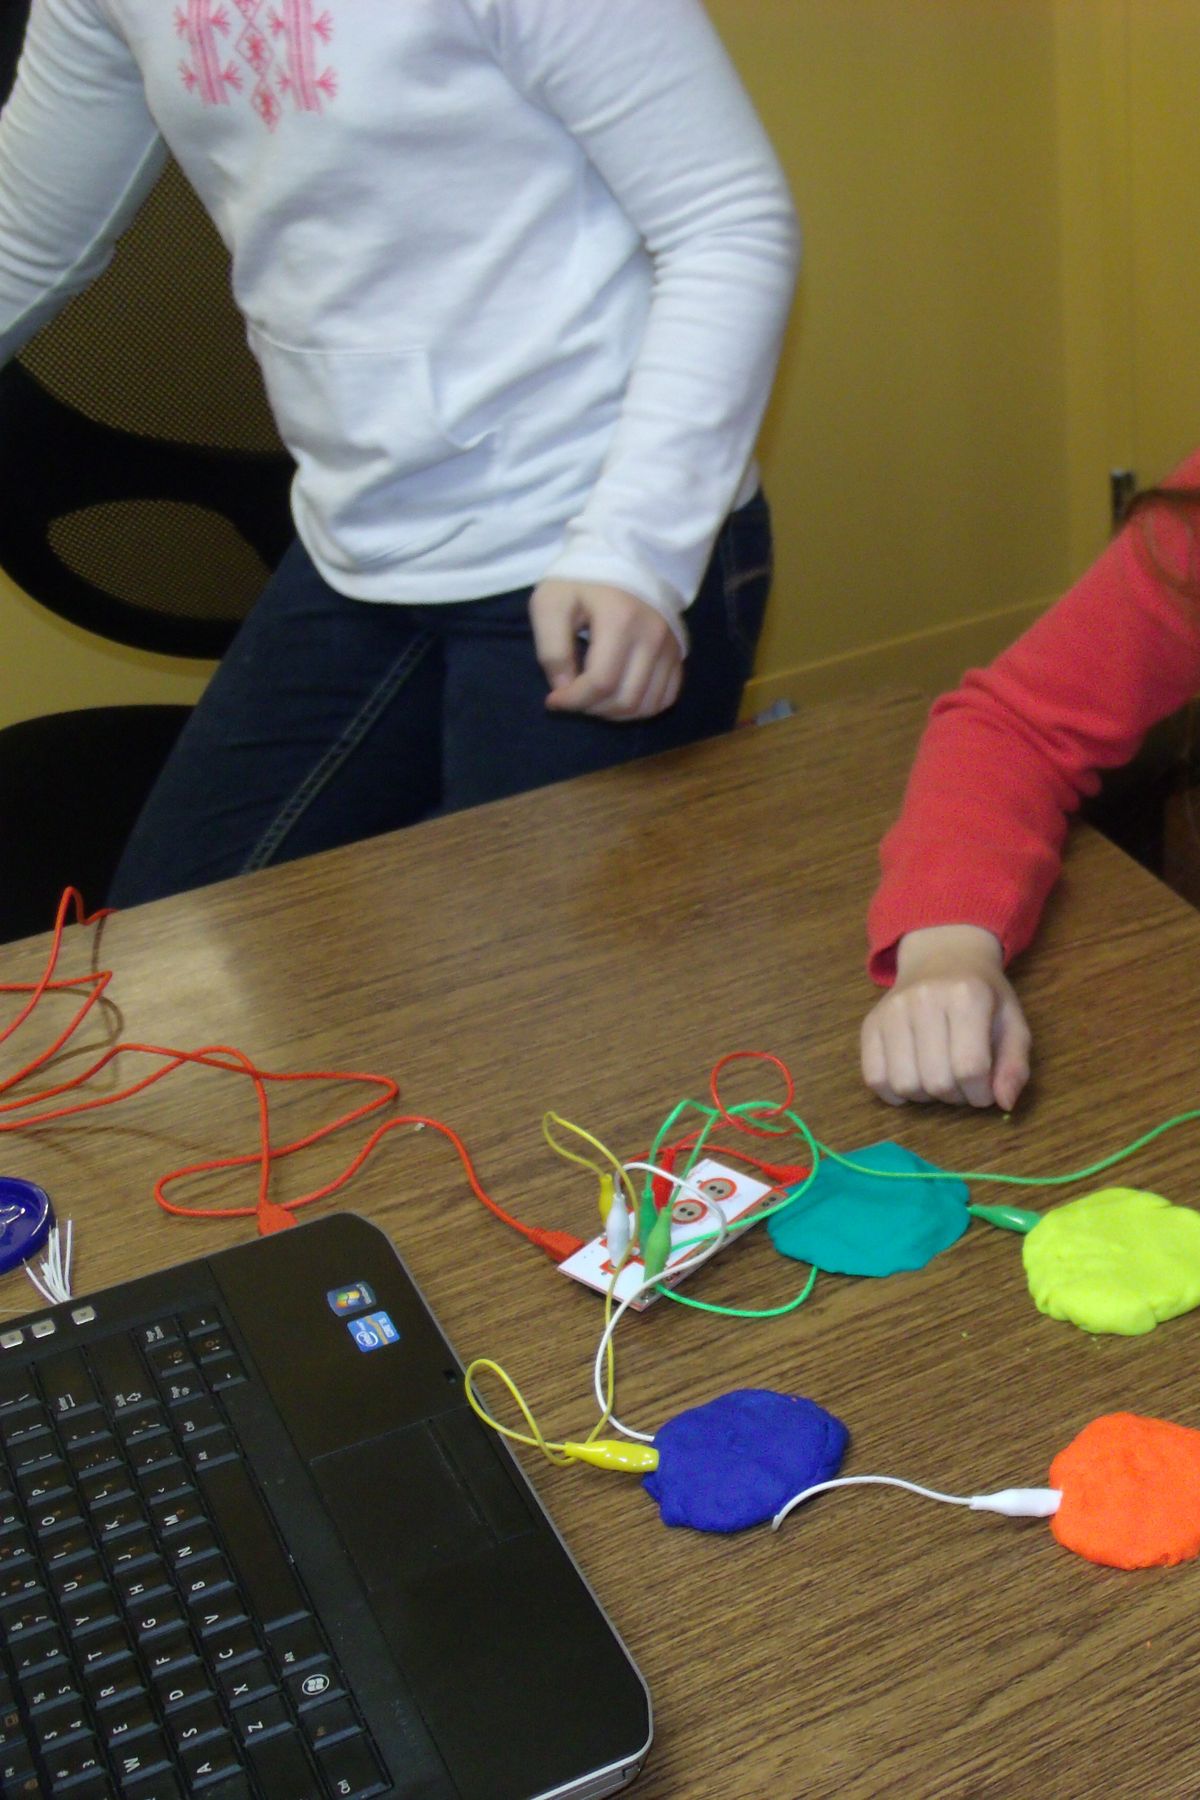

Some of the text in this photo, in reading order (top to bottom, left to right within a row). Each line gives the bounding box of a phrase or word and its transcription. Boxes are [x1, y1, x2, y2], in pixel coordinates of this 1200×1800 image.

[31, 1489, 46, 1497] P
[95, 1490, 108, 1499] L
[41, 1516, 56, 1526] O
[104, 1520, 120, 1530] K
[163, 1514, 180, 1526] M
[178, 1547, 192, 1557] N
[63, 1581, 79, 1592] U
[128, 1584, 145, 1596] H
[191, 1580, 206, 1591] B
[35, 1615, 48, 1623] 7
[75, 1616, 90, 1626] Y
[142, 1619, 156, 1628] G
[205, 1615, 218, 1624] V
[46, 1649, 59, 1657] 6
[88, 1652, 101, 1660] T
[219, 1649, 233, 1658] C
[156, 1656, 171, 1665] F
[58, 1686, 71, 1695] 5
[101, 1686, 114, 1697] R
[234, 1684, 248, 1695] X
[170, 1690, 183, 1700] D
[113, 1723, 128, 1735] E
[248, 1722, 263, 1732] Z
[183, 1728, 197, 1737] S
[83, 1760, 95, 1768] 3
[124, 1758, 140, 1772] W
[197, 1763, 211, 1773] A
